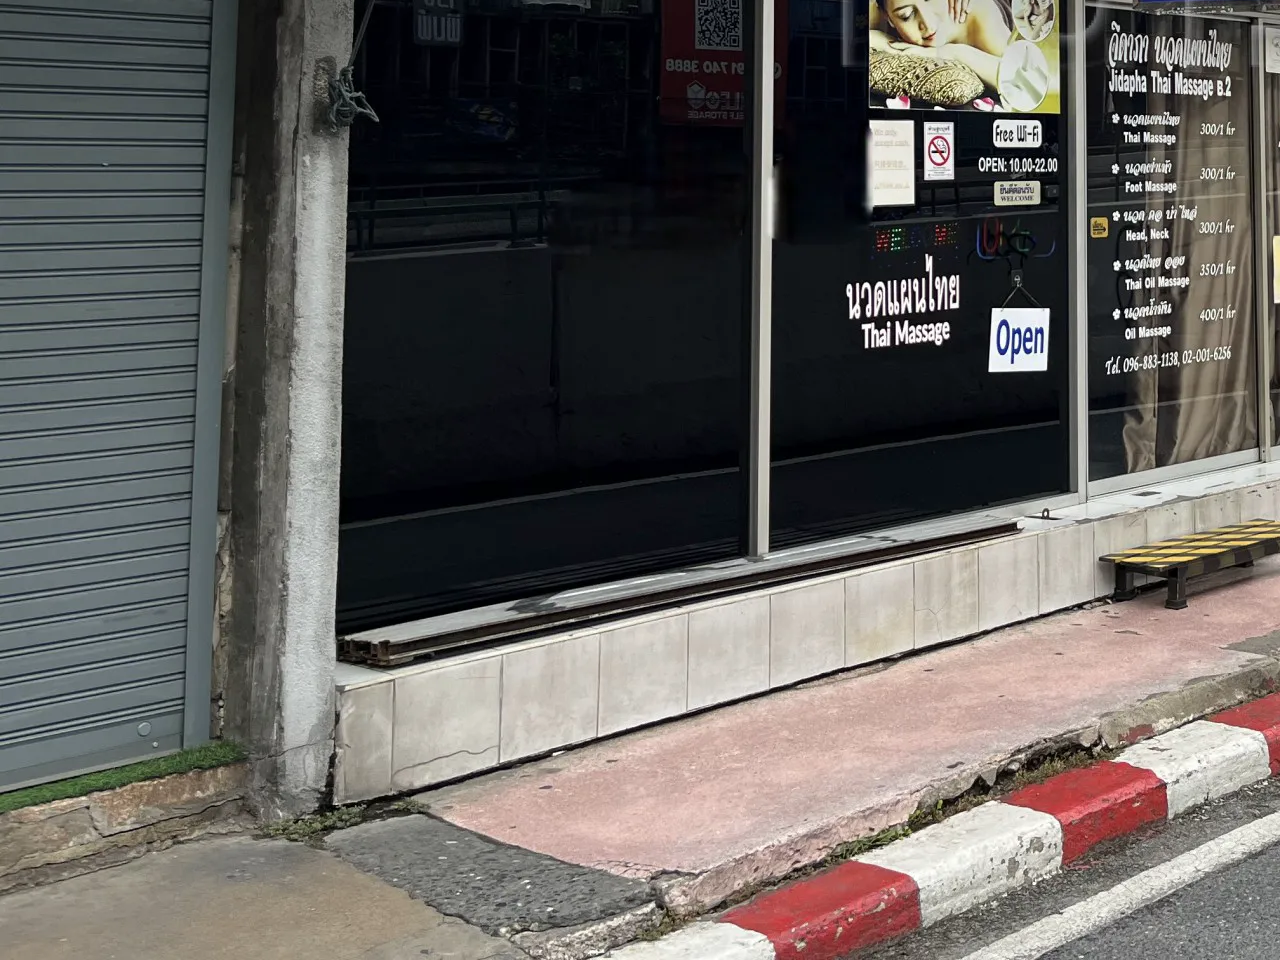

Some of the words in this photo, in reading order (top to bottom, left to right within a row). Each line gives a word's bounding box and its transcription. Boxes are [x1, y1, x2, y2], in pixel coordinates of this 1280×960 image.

[1155, 28, 1233, 72] นวดแผนไทย
[1109, 69, 1147, 97] Jidapha
[1150, 71, 1172, 94] Thai
[1174, 72, 1213, 100] Massage
[1216, 76, 1231, 97] B.2
[995, 125, 1014, 142] Free
[1017, 125, 1039, 142] Wi-Fi
[1200, 123, 1224, 136] 300/1
[1226, 121, 1236, 136] hr
[1123, 132, 1141, 143] Thai
[1143, 131, 1176, 145] Massage
[978, 157, 1007, 172] OPEN:
[1009, 157, 1058, 172] 10.00-22.00
[1200, 167, 1224, 181] 300/1
[1226, 166, 1236, 180] hr
[1125, 181, 1142, 193] Foot
[1145, 181, 1177, 194] Massage
[1123, 210, 1145, 224] นวด
[1126, 229, 1148, 242] Head,
[1150, 228, 1169, 240] Neck
[1199, 221, 1223, 235] 300/1
[1225, 219, 1235, 233] hr
[1200, 263, 1224, 276] 350/1
[1226, 260, 1236, 275] hr
[846, 254, 960, 319] นวดแผนไทย
[1125, 278, 1142, 290] Thai
[1145, 277, 1155, 289] Oil
[1158, 276, 1190, 288] Massage
[1200, 308, 1224, 321] 400/1
[1226, 304, 1236, 319] hr
[862, 322, 891, 348] Thai
[895, 320, 950, 346] Massage
[1125, 327, 1136, 340] Oil
[1139, 325, 1172, 338] Massage
[996, 319, 1044, 364] Open
[1105, 355, 1120, 375] Tel.
[1123, 351, 1180, 372] 096-883-1138,
[1182, 346, 1231, 364] 02-001-6256
